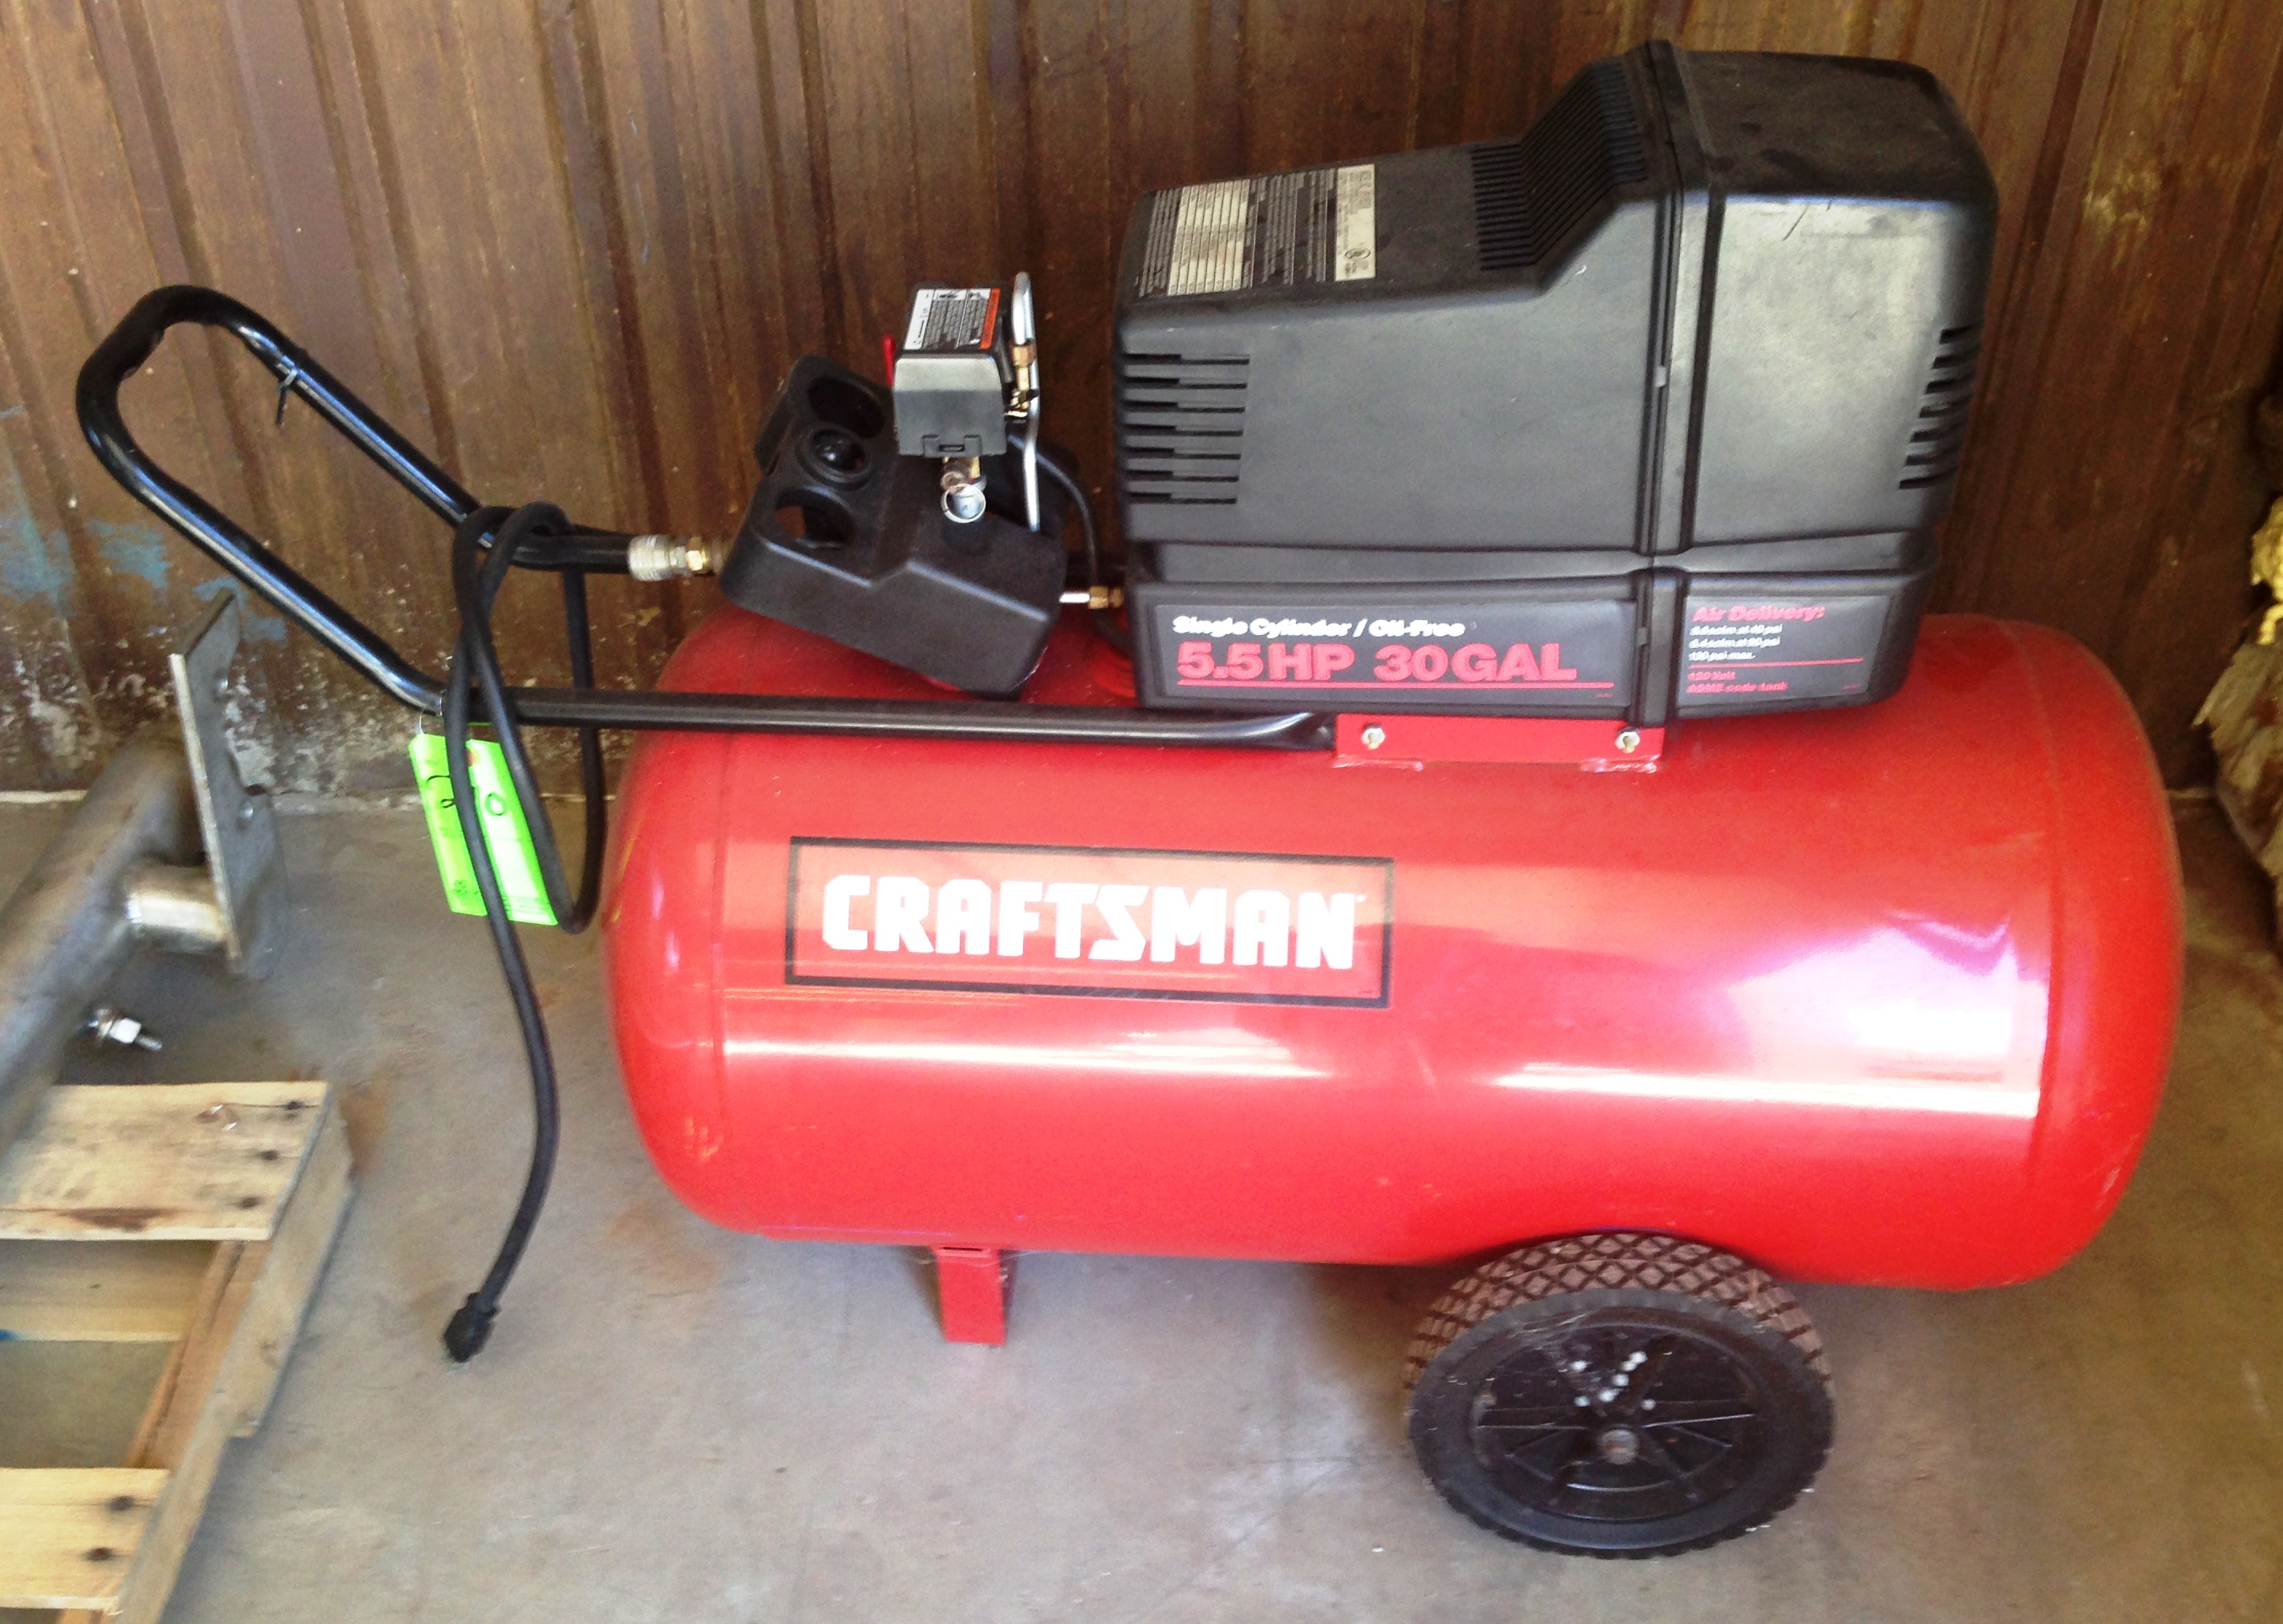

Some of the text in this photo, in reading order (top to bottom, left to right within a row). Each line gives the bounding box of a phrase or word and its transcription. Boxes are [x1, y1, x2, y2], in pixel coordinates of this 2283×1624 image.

[1692, 606, 1726, 622] Air
[1172, 616, 1248, 637] Single
[1249, 618, 1352, 638] Cylinder
[1369, 619, 1466, 637] Oil-Free
[823, 875, 1355, 970] CRAFTSMAN
